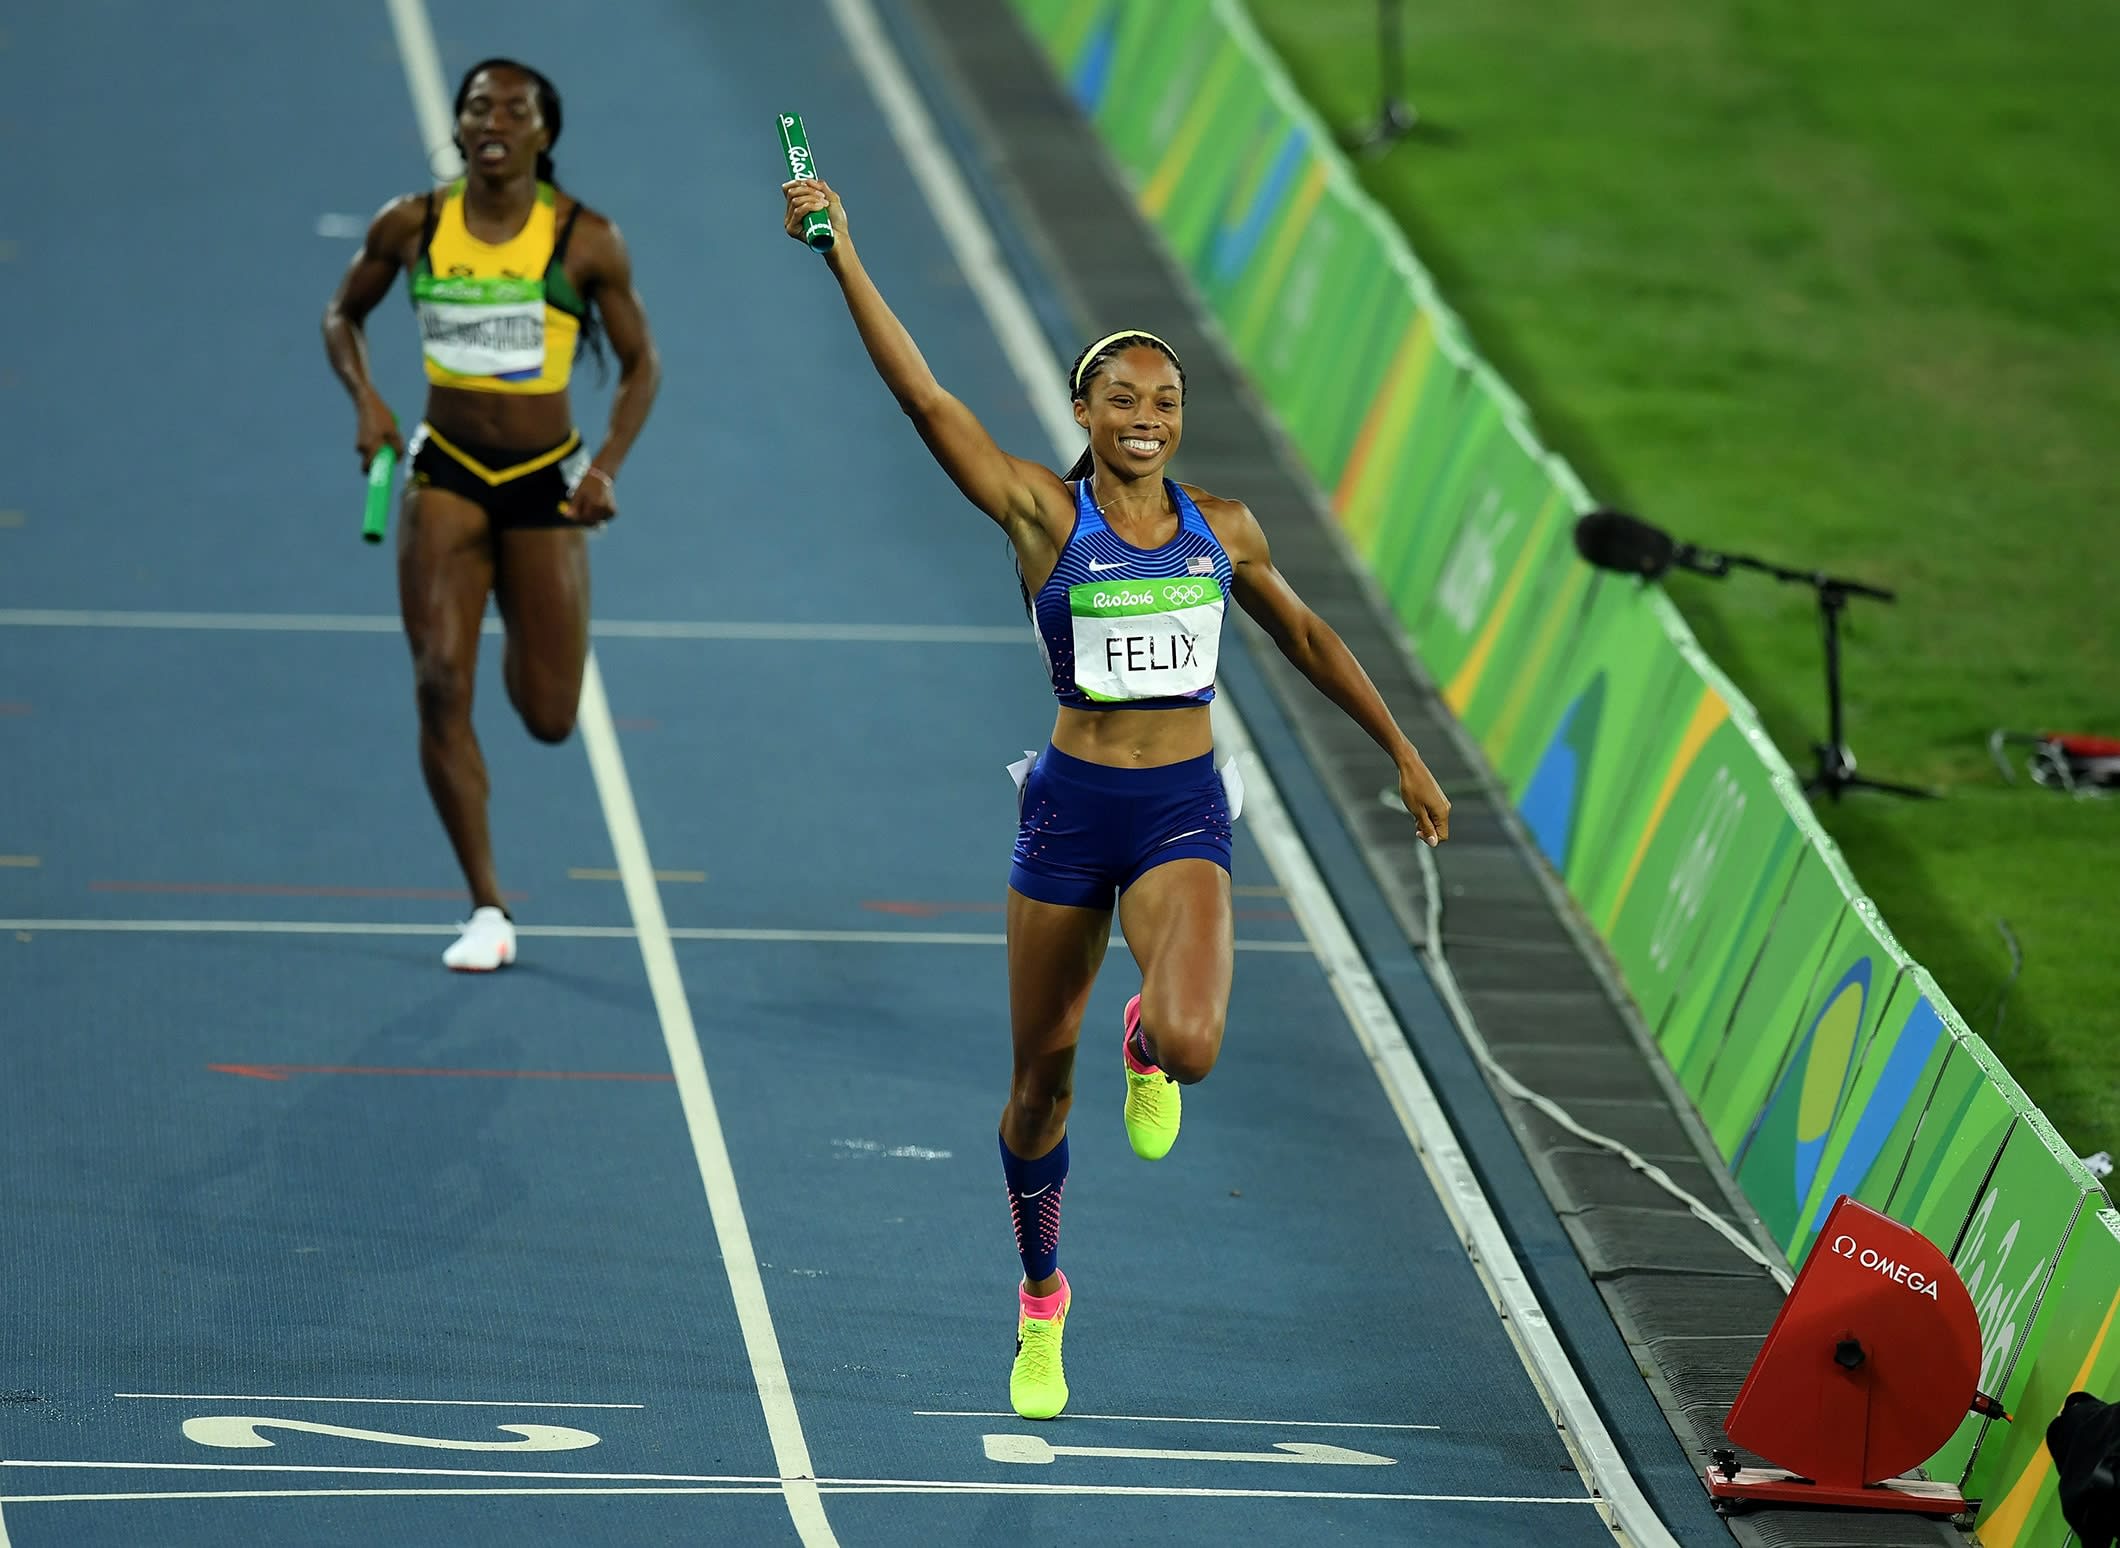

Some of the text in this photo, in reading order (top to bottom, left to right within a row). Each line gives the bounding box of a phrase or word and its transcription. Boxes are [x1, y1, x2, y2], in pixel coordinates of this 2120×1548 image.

[788, 146, 815, 181] Rio2
[1093, 590, 1154, 609] Rio2016
[1106, 634, 1199, 672] FELIX
[1859, 1249, 1938, 1301] OMEGA
[182, 1416, 602, 1452] 2
[982, 1434, 1399, 1466] 1
